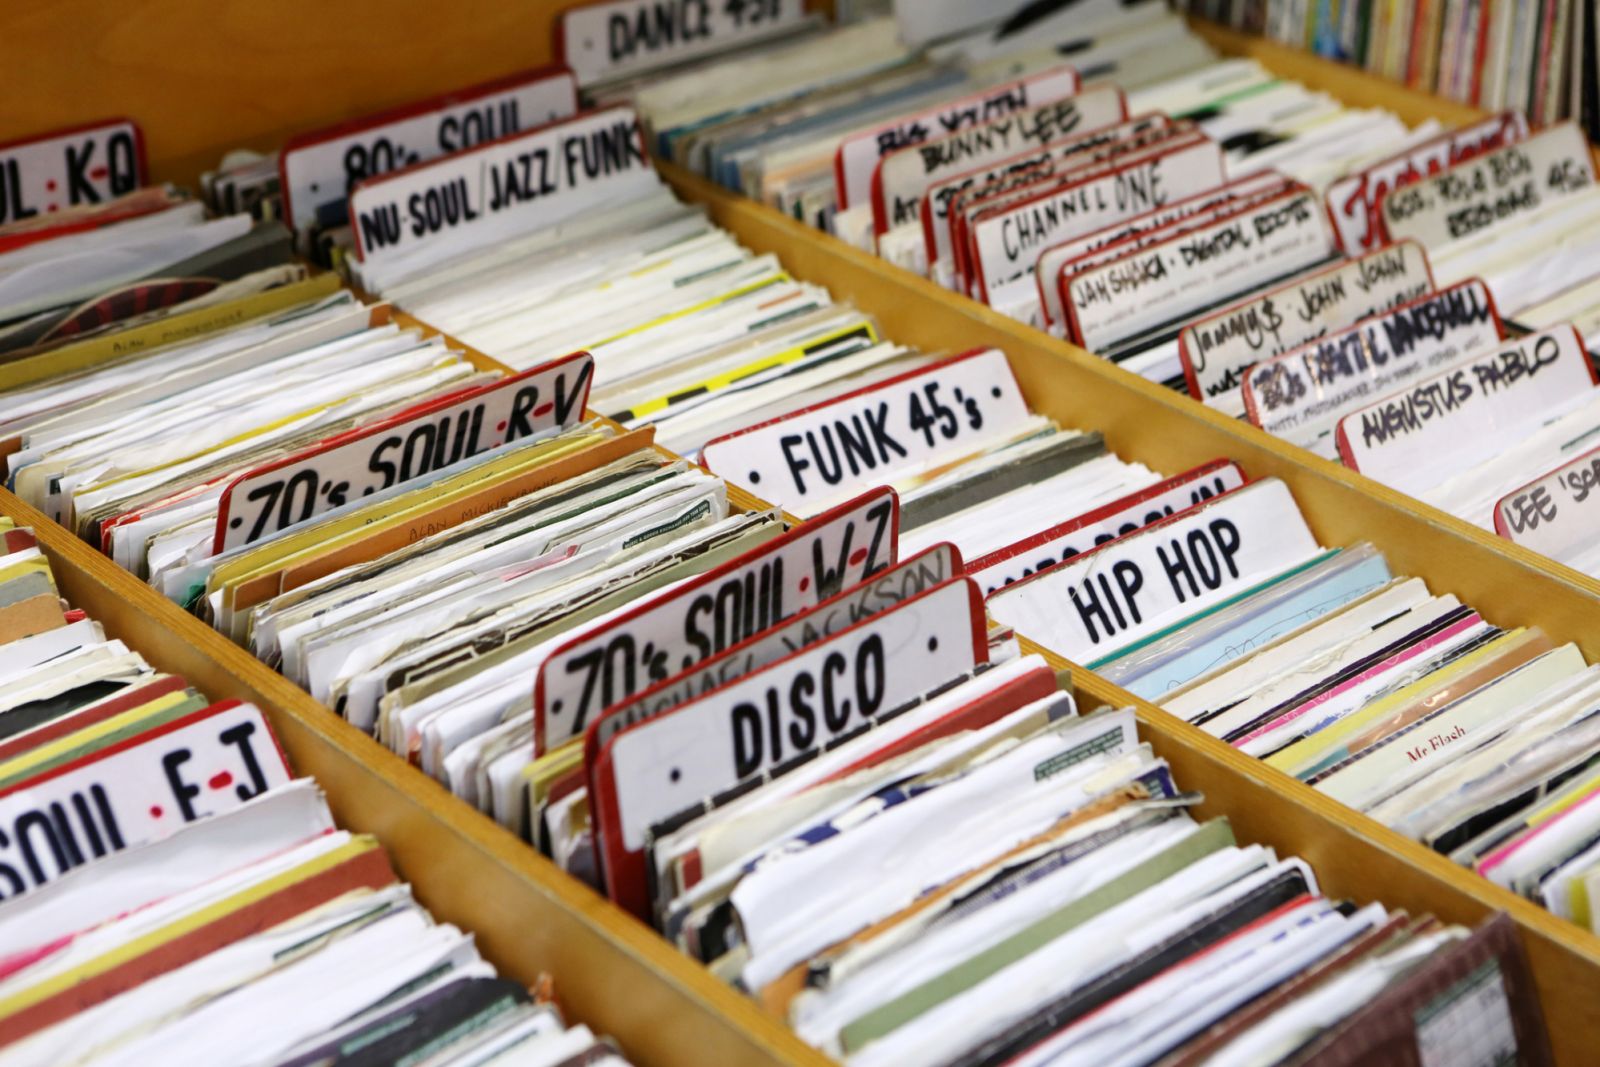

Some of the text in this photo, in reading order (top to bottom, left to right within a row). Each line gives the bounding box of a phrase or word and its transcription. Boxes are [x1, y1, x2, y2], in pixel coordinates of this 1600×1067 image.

[920, 119, 1012, 174] BUNNY
[1018, 99, 1082, 144] LEE
[1001, 186, 1106, 262] CHANNEL
[1113, 160, 1169, 212] ONE
[780, 381, 984, 495] FUNK 45's
[1361, 372, 1473, 448] AUGUSTUS
[1474, 335, 1560, 398] PABLO
[363, 403, 490, 495] SOUL
[1504, 486, 1557, 534] LEE
[682, 555, 795, 668] SOUL
[1067, 560, 1144, 644] HIP
[1156, 518, 1241, 603] HOP
[731, 632, 885, 780] DISCO
[1428, 725, 1466, 751] Flash
